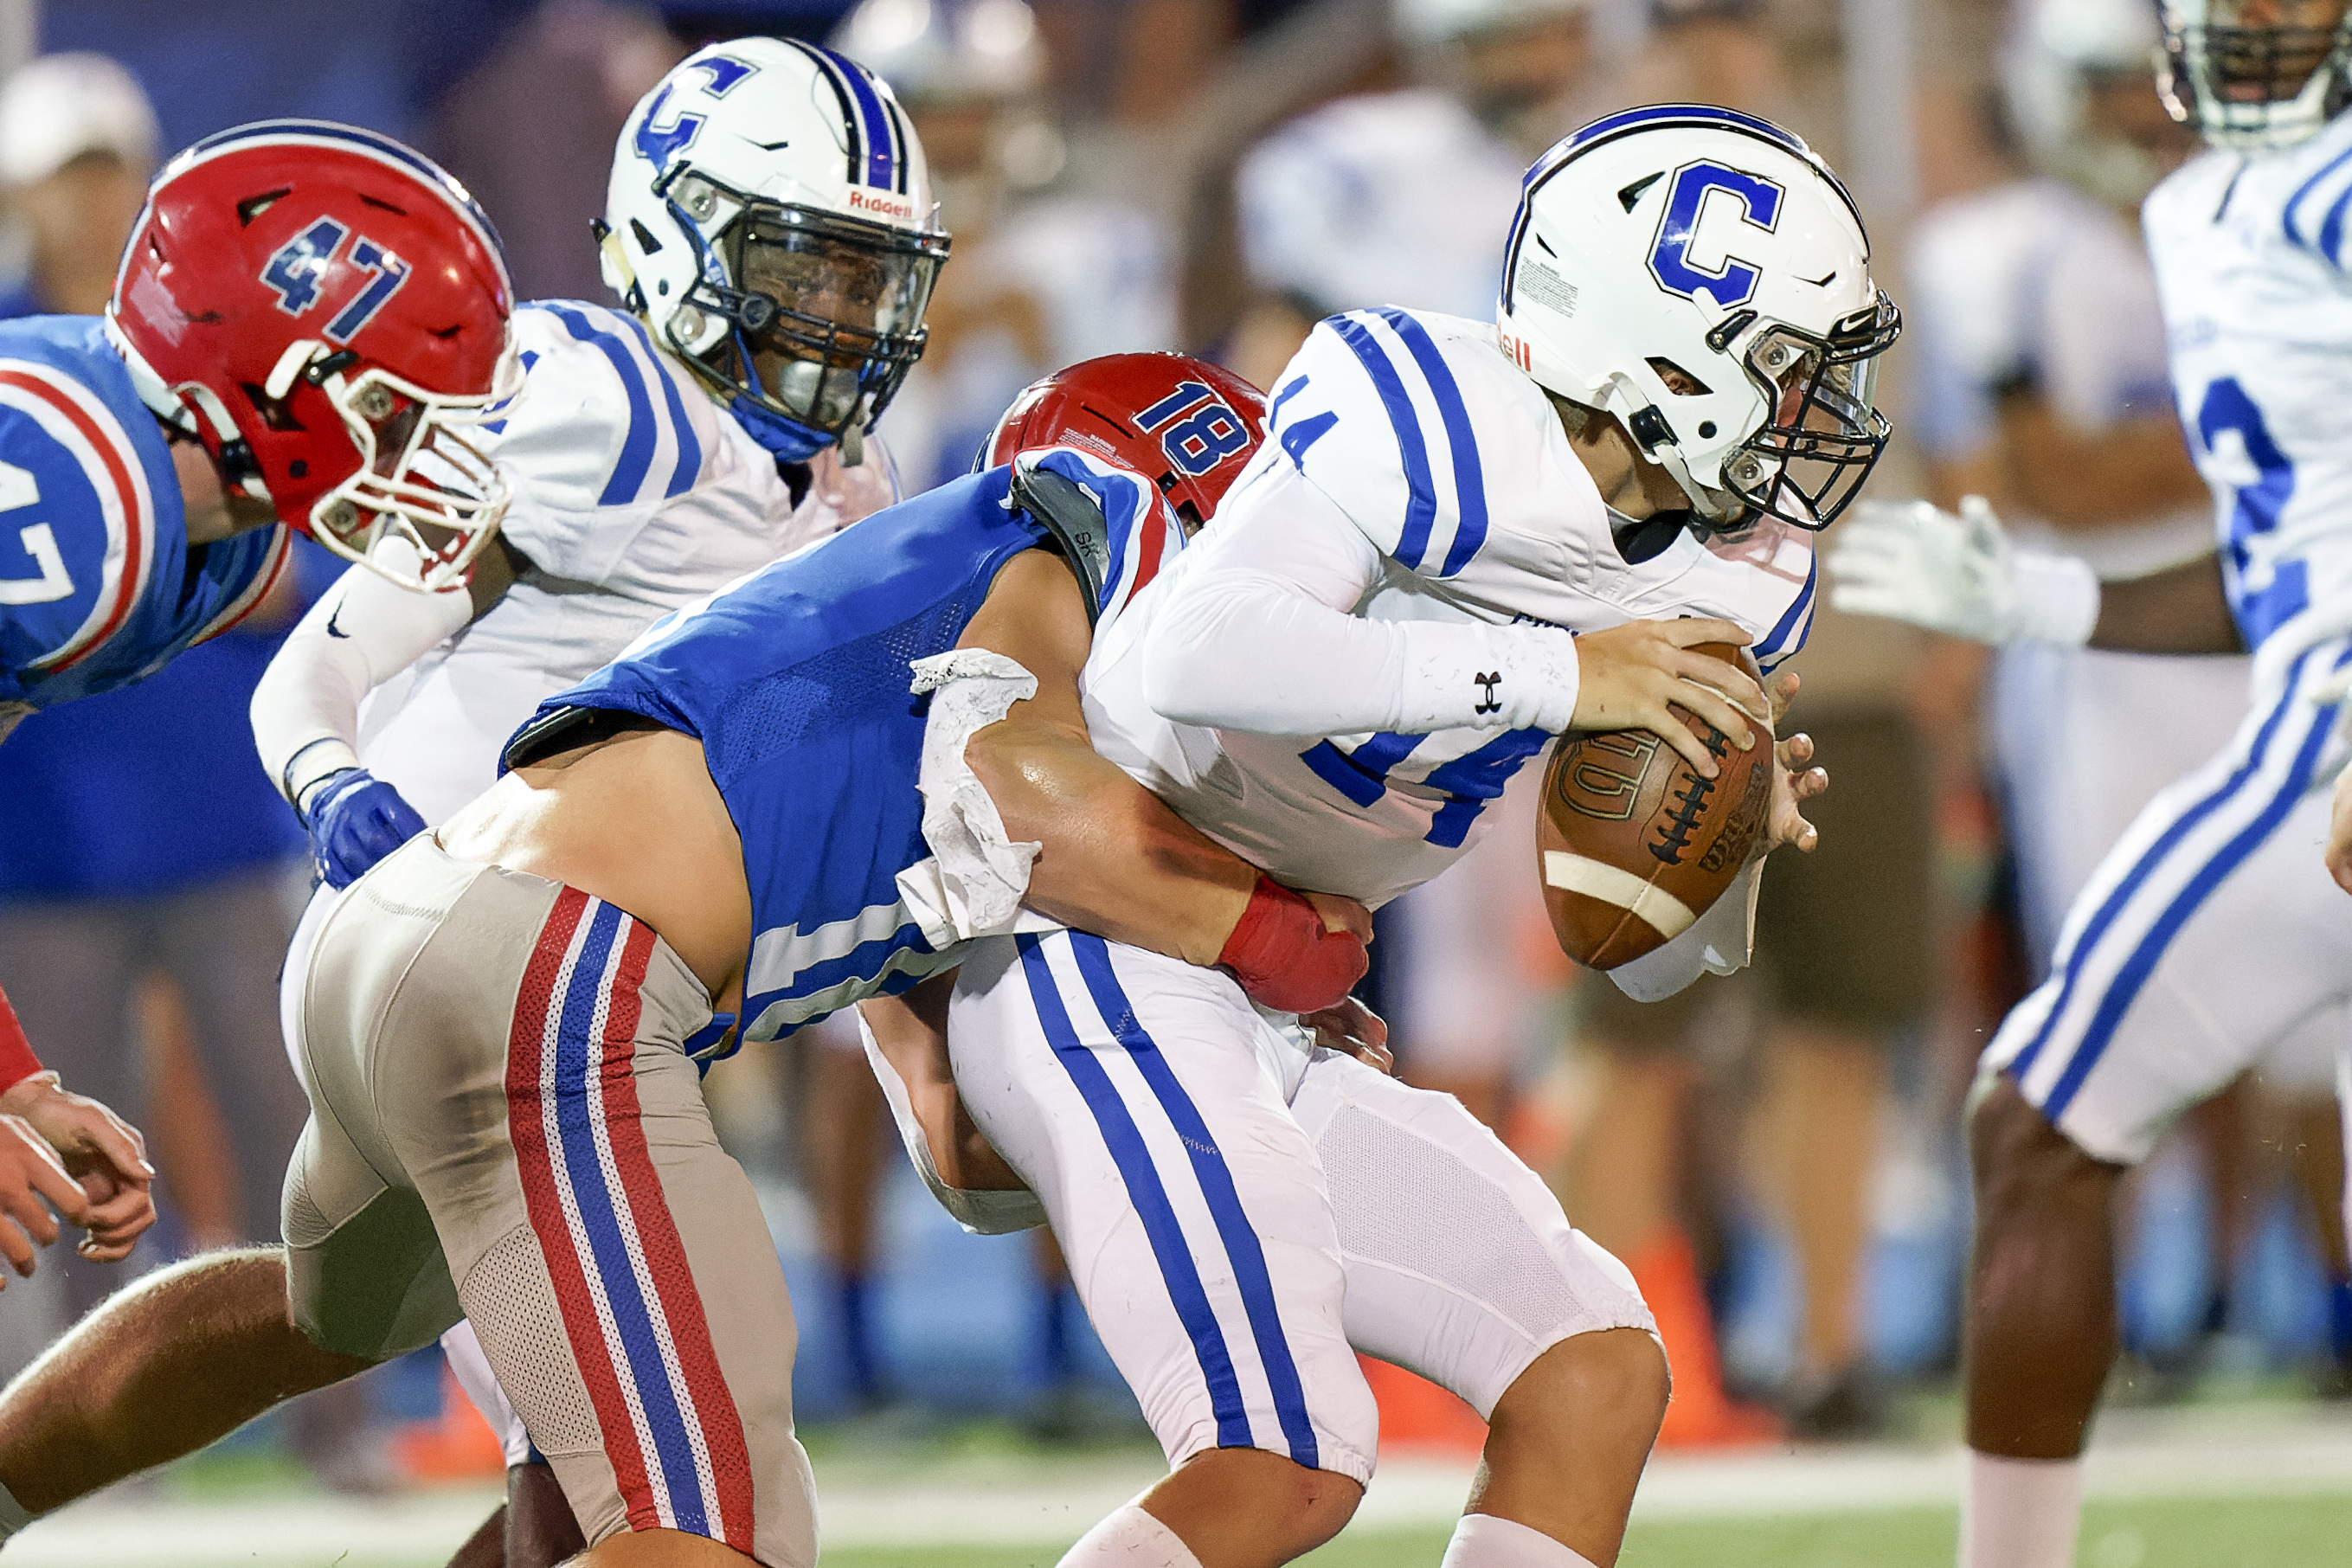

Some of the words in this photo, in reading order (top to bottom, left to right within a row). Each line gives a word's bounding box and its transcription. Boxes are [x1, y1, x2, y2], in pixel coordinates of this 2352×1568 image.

[260, 215, 411, 344] 47
[1645, 158, 1786, 312] C
[1132, 381, 1250, 476] 18
